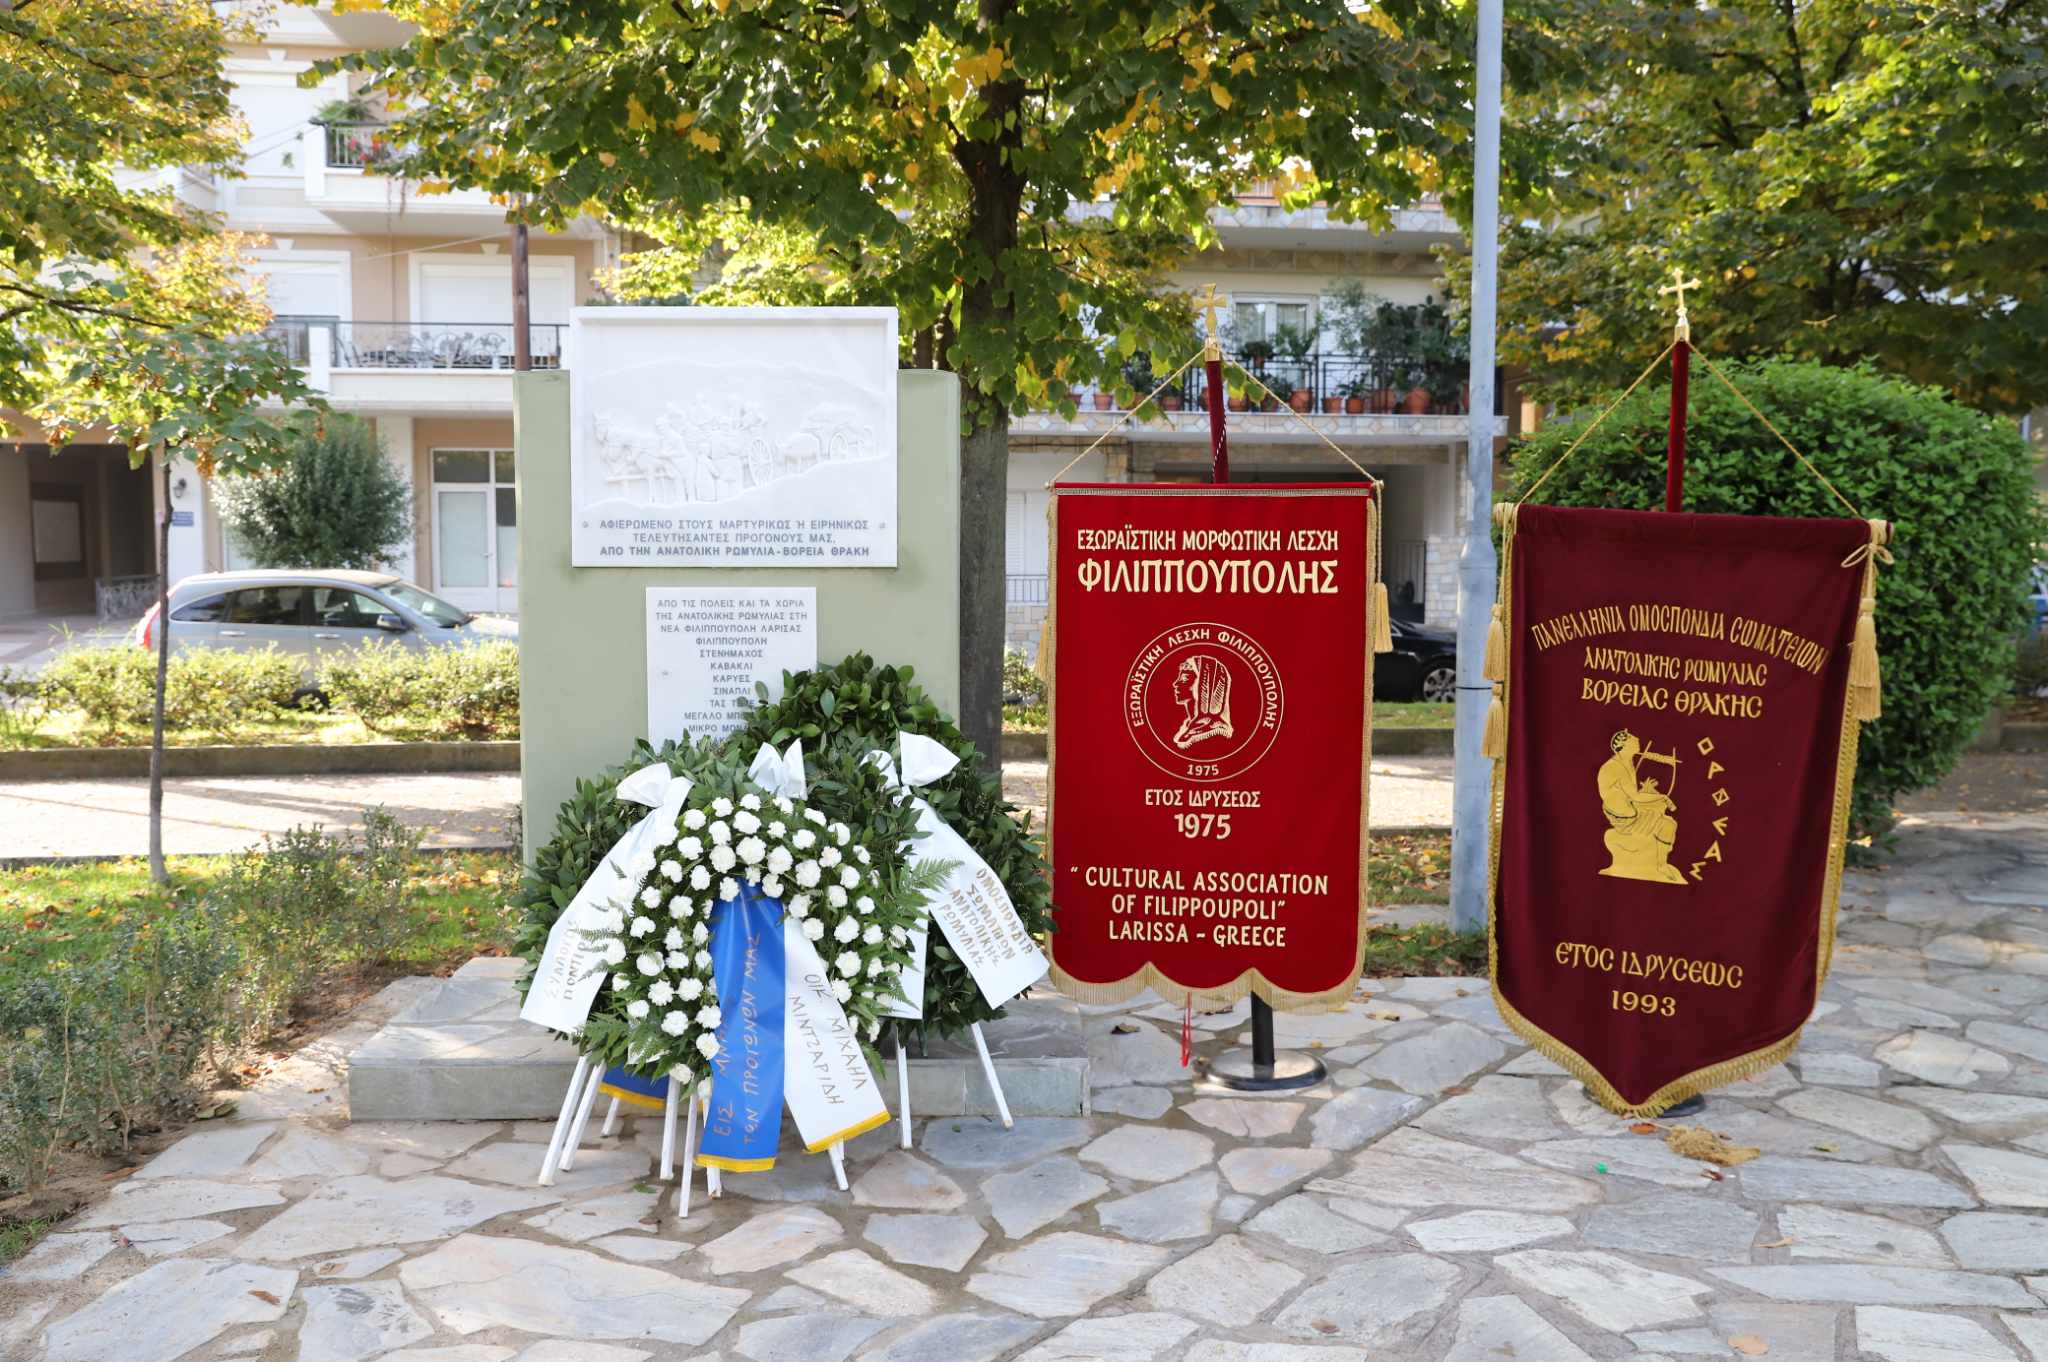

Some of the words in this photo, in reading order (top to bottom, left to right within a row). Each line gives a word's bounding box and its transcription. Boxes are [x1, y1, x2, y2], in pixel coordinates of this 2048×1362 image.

[599, 519, 672, 530] ΑΦΙΕΡΩΜΕΝΟ
[678, 519, 713, 530] ΣΤΟΥΣ
[719, 519, 790, 530] ΜΑΡΤΥΡΙΚΩΣ
[810, 519, 867, 530] ΕΙΡΗΝΙΚΩΣ
[632, 532, 729, 543] ΤΕΛΕΥΤΗΣΑΝΤΕΣ
[735, 532, 803, 544] ΠΡΟΓΟΝΟΥΣ
[1182, 530, 1280, 550] ΜΟΡΦΩΤΙΚΗ
[1287, 530, 1338, 550] ΛΕΣΧΗ
[599, 545, 623, 556] ΑΠΟ
[629, 546, 650, 556] ΤΗΝ
[656, 546, 719, 556] ΑΝΑΤΟΛΙΚΗ
[830, 546, 869, 557] ΘΡΑΚΗ
[1078, 558, 1338, 593] ΦΙΛΙΠΠΟΥΠΟΛΗΣ
[657, 599, 677, 608] ΑΠΟ
[681, 599, 696, 608] ΤΙΣ
[700, 599, 734, 608] ΠΟΛΕΙΣ
[738, 599, 754, 608] ΚΑΙ
[759, 599, 770, 608] ΤΑ
[655, 611, 672, 621] ΤΗΣ
[677, 611, 734, 621] ΑΝΑΤΟΛΙΚΗΣ
[738, 611, 784, 621] ΡΩΜΥΛΙΑΣ
[789, 611, 807, 621] ΣΤΗ
[660, 624, 679, 633] ΝΕΑ
[699, 649, 762, 658] ΣΤΕΝΗΜΑΧΟΣ
[710, 661, 752, 671] ΚΑΒΑΚΛΙ
[712, 674, 750, 683] ΚΑΡΥΕΣ
[1168, 628, 1210, 648] ΛΕΣΧΗ
[1217, 631, 1278, 730] ΦΙΛΙΠΠΟΥΠΟΛΗΣ
[713, 687, 750, 696] ΣΙΝΑΠΛΙ
[709, 699, 725, 708] ΤΑΣ
[683, 711, 722, 721] ΜΕΓΑΛΟ
[688, 724, 717, 733] ΜΙΚΡΟ
[1186, 764, 1220, 776] 1975
[1146, 789, 1183, 806] ΕΤΟΣ
[1189, 791, 1260, 807] ΙΔΡΥΣΕΩΣ
[1174, 814, 1230, 839] 1975
[1193, 872, 1328, 894] ASSOCIATION
[1112, 894, 1136, 913] OF
[1110, 920, 1188, 942] LARISSA
[1214, 925, 1286, 947] GREECE
[1613, 991, 1675, 1016] 1993
[829, 1017, 868, 1090] ΜΙΧΑΗΛ
